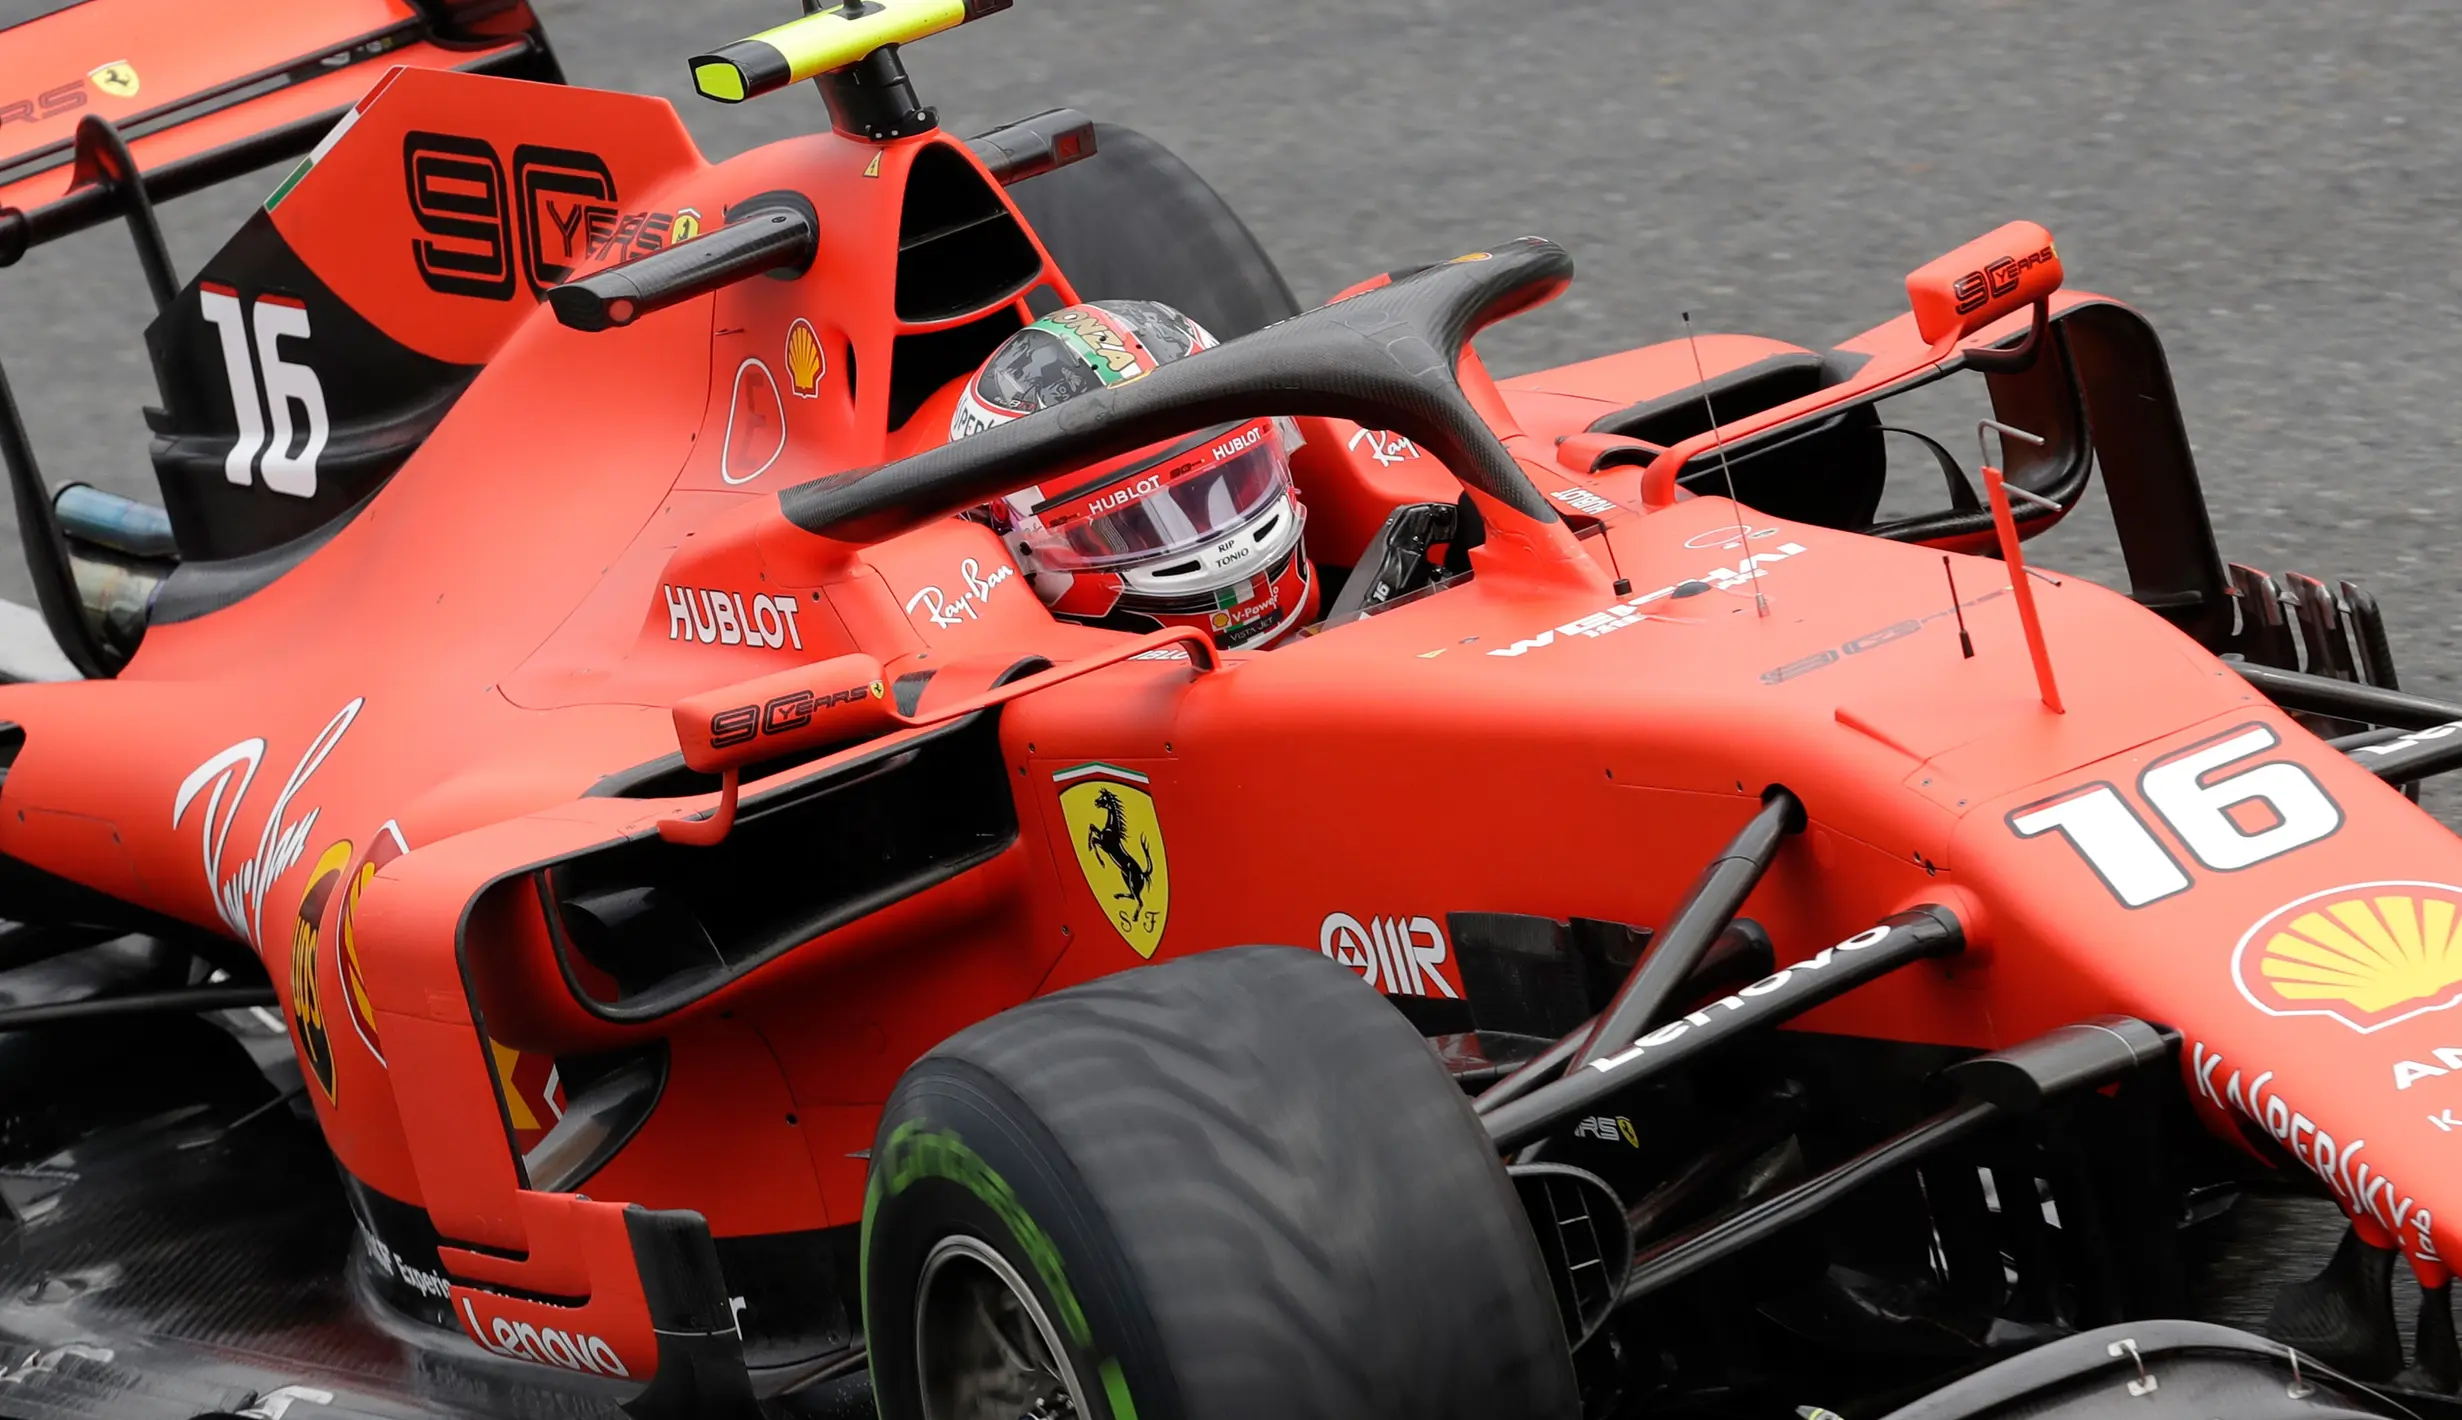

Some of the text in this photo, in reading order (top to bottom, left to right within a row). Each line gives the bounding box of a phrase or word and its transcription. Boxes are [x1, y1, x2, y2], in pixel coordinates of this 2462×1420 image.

[403, 130, 618, 306] 90
[1953, 246, 2053, 315] 90 YEARS
[200, 281, 330, 499] 16
[1212, 427, 1262, 461] HUBLOT
[1088, 474, 1160, 515] HUBLOT
[1550, 487, 1617, 515] HUBLOT
[1215, 547, 1250, 568] TONIO
[1218, 540, 1235, 553] RIP
[664, 584, 803, 650] HUBLOT
[905, 557, 1014, 629] Ray-Ban
[1232, 594, 1279, 622] V-Power
[1372, 580, 1391, 602] 16
[709, 685, 869, 749] 90 YEARS
[2004, 720, 2346, 911] 16
[1588, 925, 1892, 1073] Lenovo
[462, 1296, 630, 1377] Lenovo
